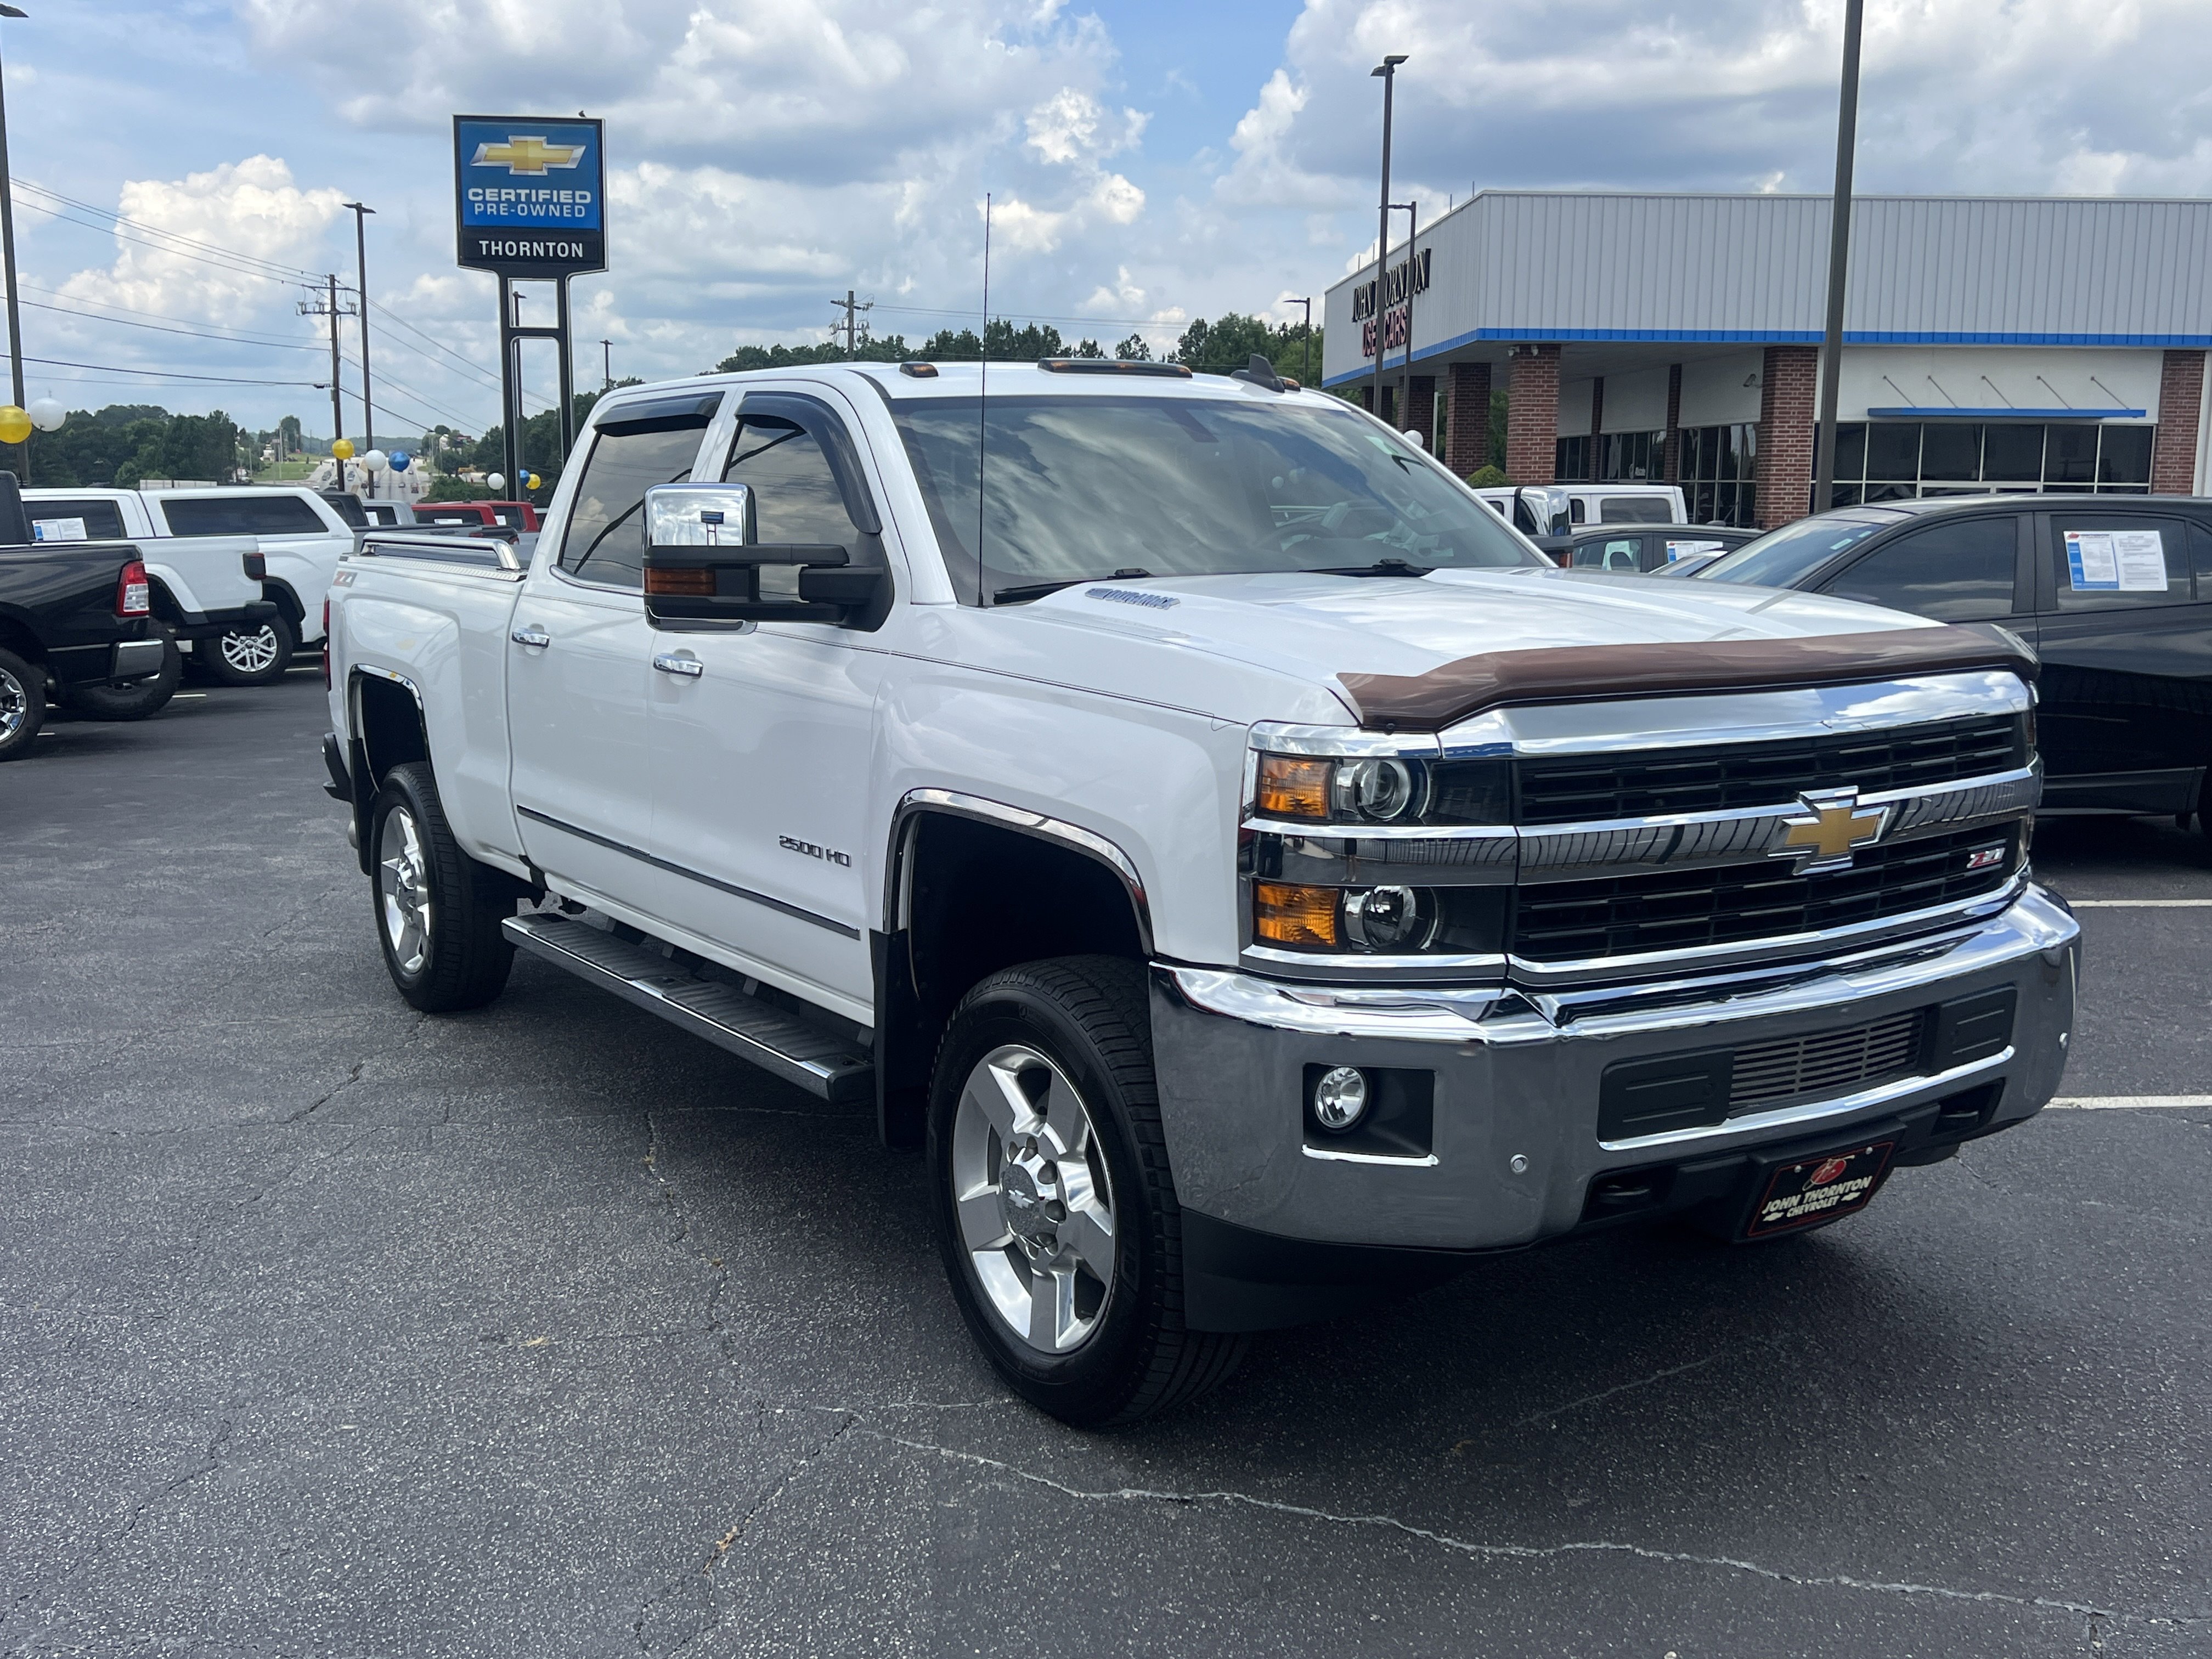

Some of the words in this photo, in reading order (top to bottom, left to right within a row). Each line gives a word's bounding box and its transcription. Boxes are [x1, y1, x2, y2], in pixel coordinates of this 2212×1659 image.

[467, 188, 591, 204] CERTIFIED
[474, 203, 585, 217] PRE-OWNED
[479, 240, 583, 258] THORNTON
[1383, 304, 1408, 349] CARS
[779, 834, 823, 860] 2500
[825, 848, 852, 868] HD
[1762, 1194, 1801, 1215] JOHN
[1803, 1175, 1874, 1202] THORNTON
[1786, 1195, 1842, 1218] CHEVROLET
